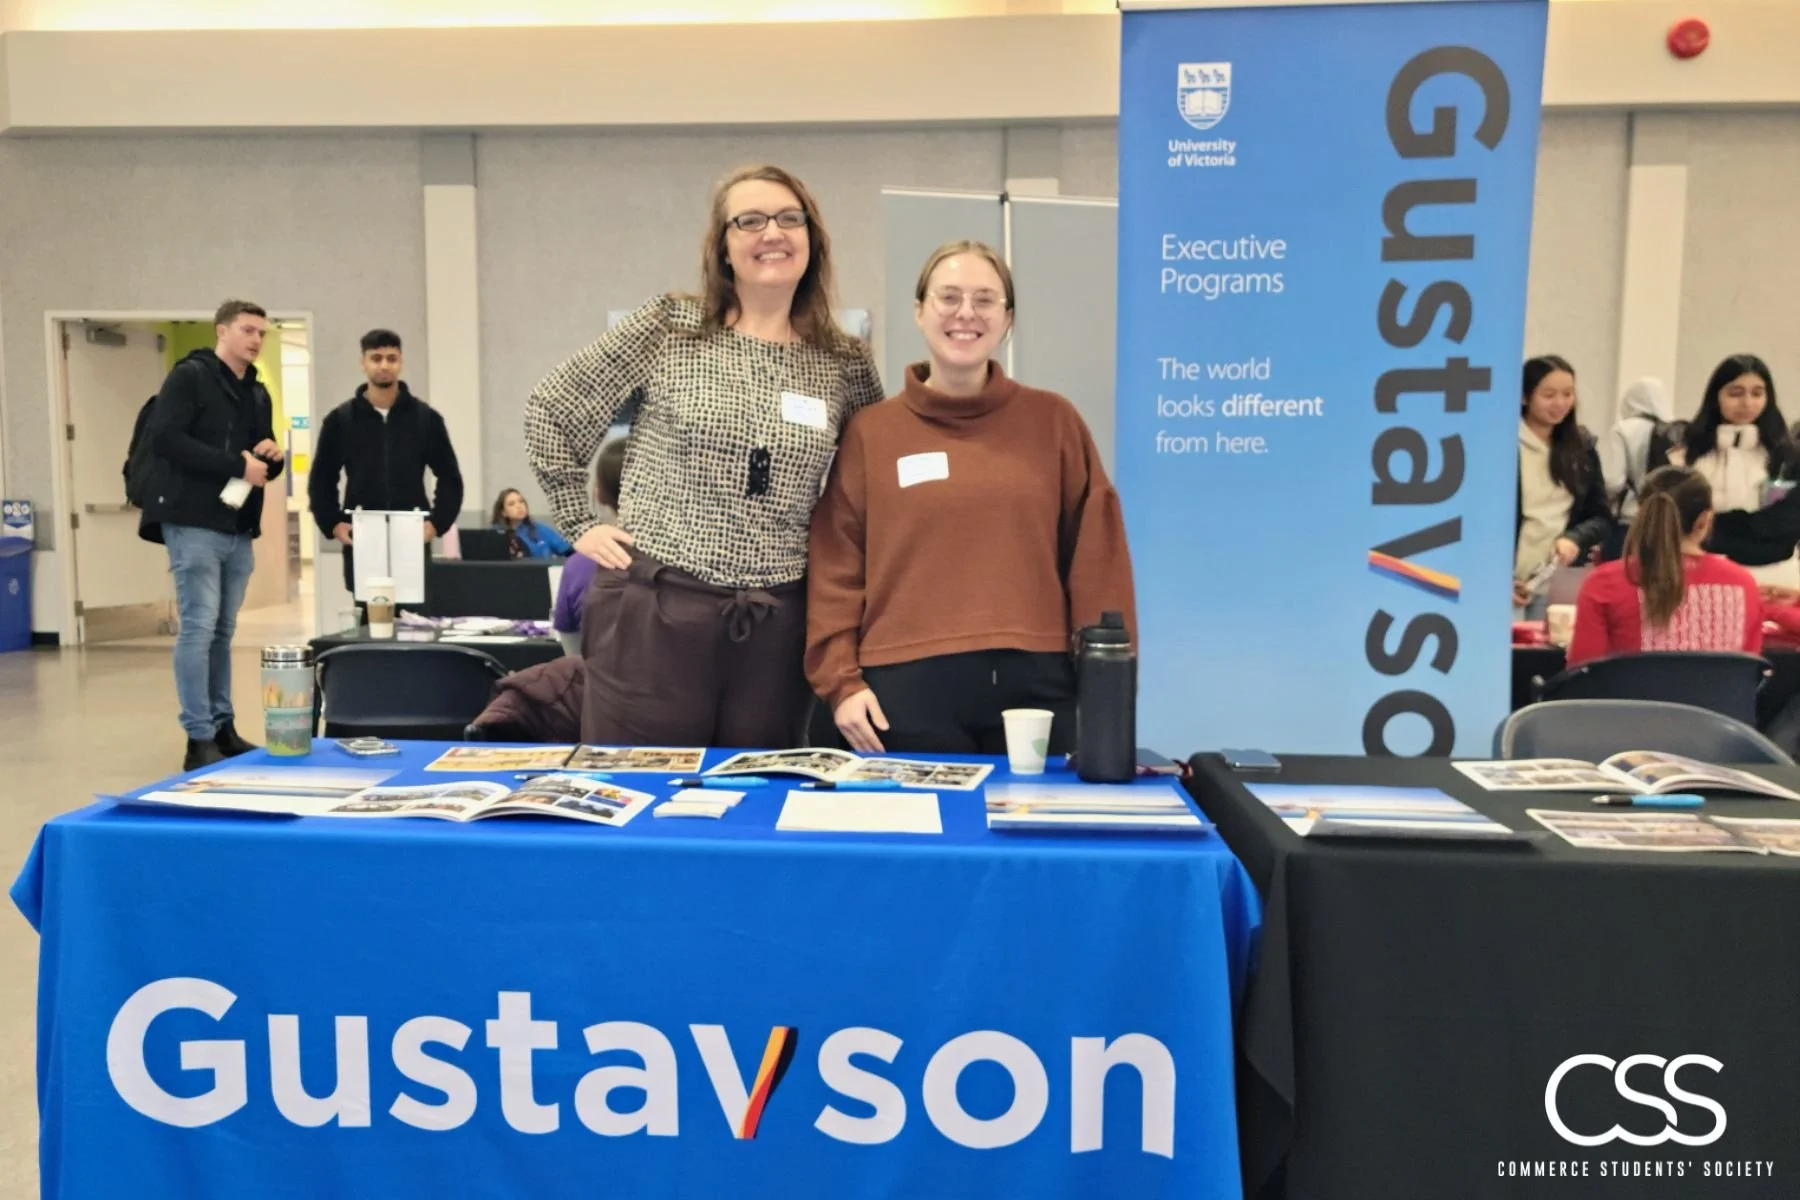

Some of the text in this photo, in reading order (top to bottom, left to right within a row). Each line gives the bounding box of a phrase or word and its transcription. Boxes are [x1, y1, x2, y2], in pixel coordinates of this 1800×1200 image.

[1168, 138, 1237, 155] University
[1167, 154, 1237, 168] of Victoria
[1161, 233, 1287, 261] Executive
[1160, 267, 1285, 301] Programs
[1157, 356, 1272, 381] The world
[1156, 392, 1325, 418] looks different
[1155, 429, 1270, 454] from here.
[105, 976, 1177, 1160] Gustavson
